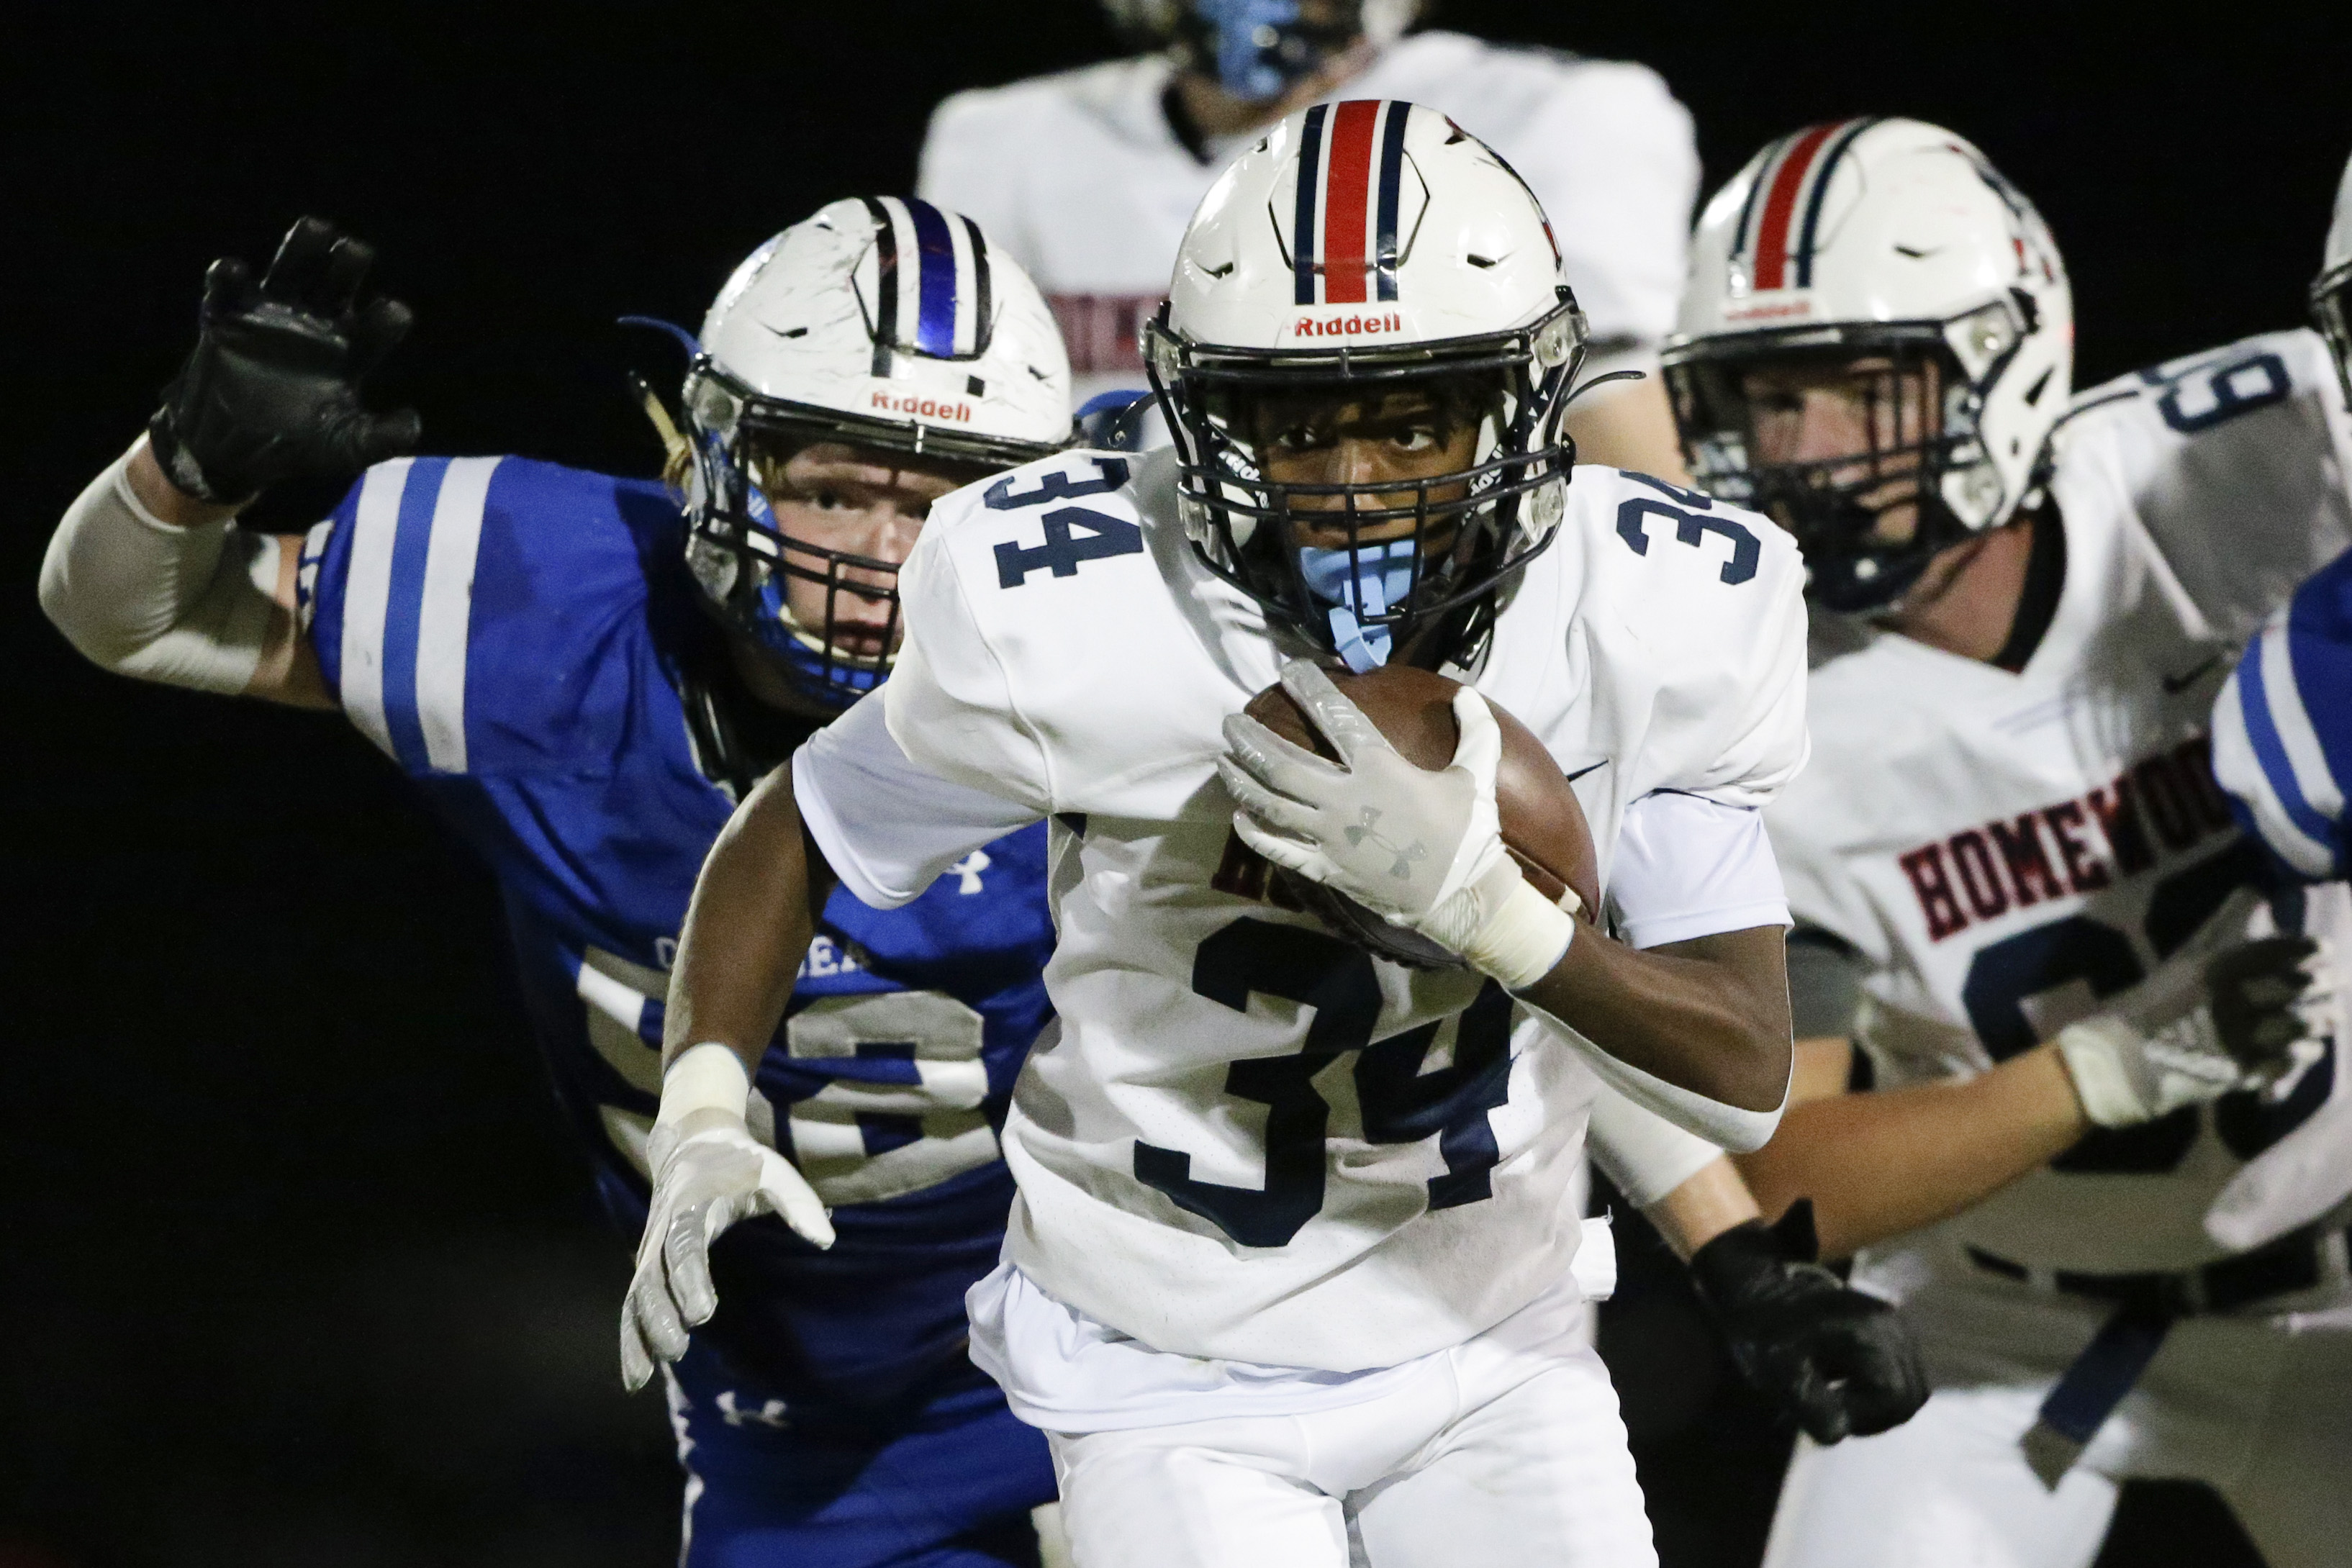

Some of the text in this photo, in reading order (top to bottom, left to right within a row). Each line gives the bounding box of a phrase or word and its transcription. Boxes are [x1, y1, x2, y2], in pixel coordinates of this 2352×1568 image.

[1295, 314, 1401, 336] Riddell
[872, 391, 970, 422] Riddell
[983, 458, 1144, 589] 34
[1134, 915, 1520, 1248] 34
